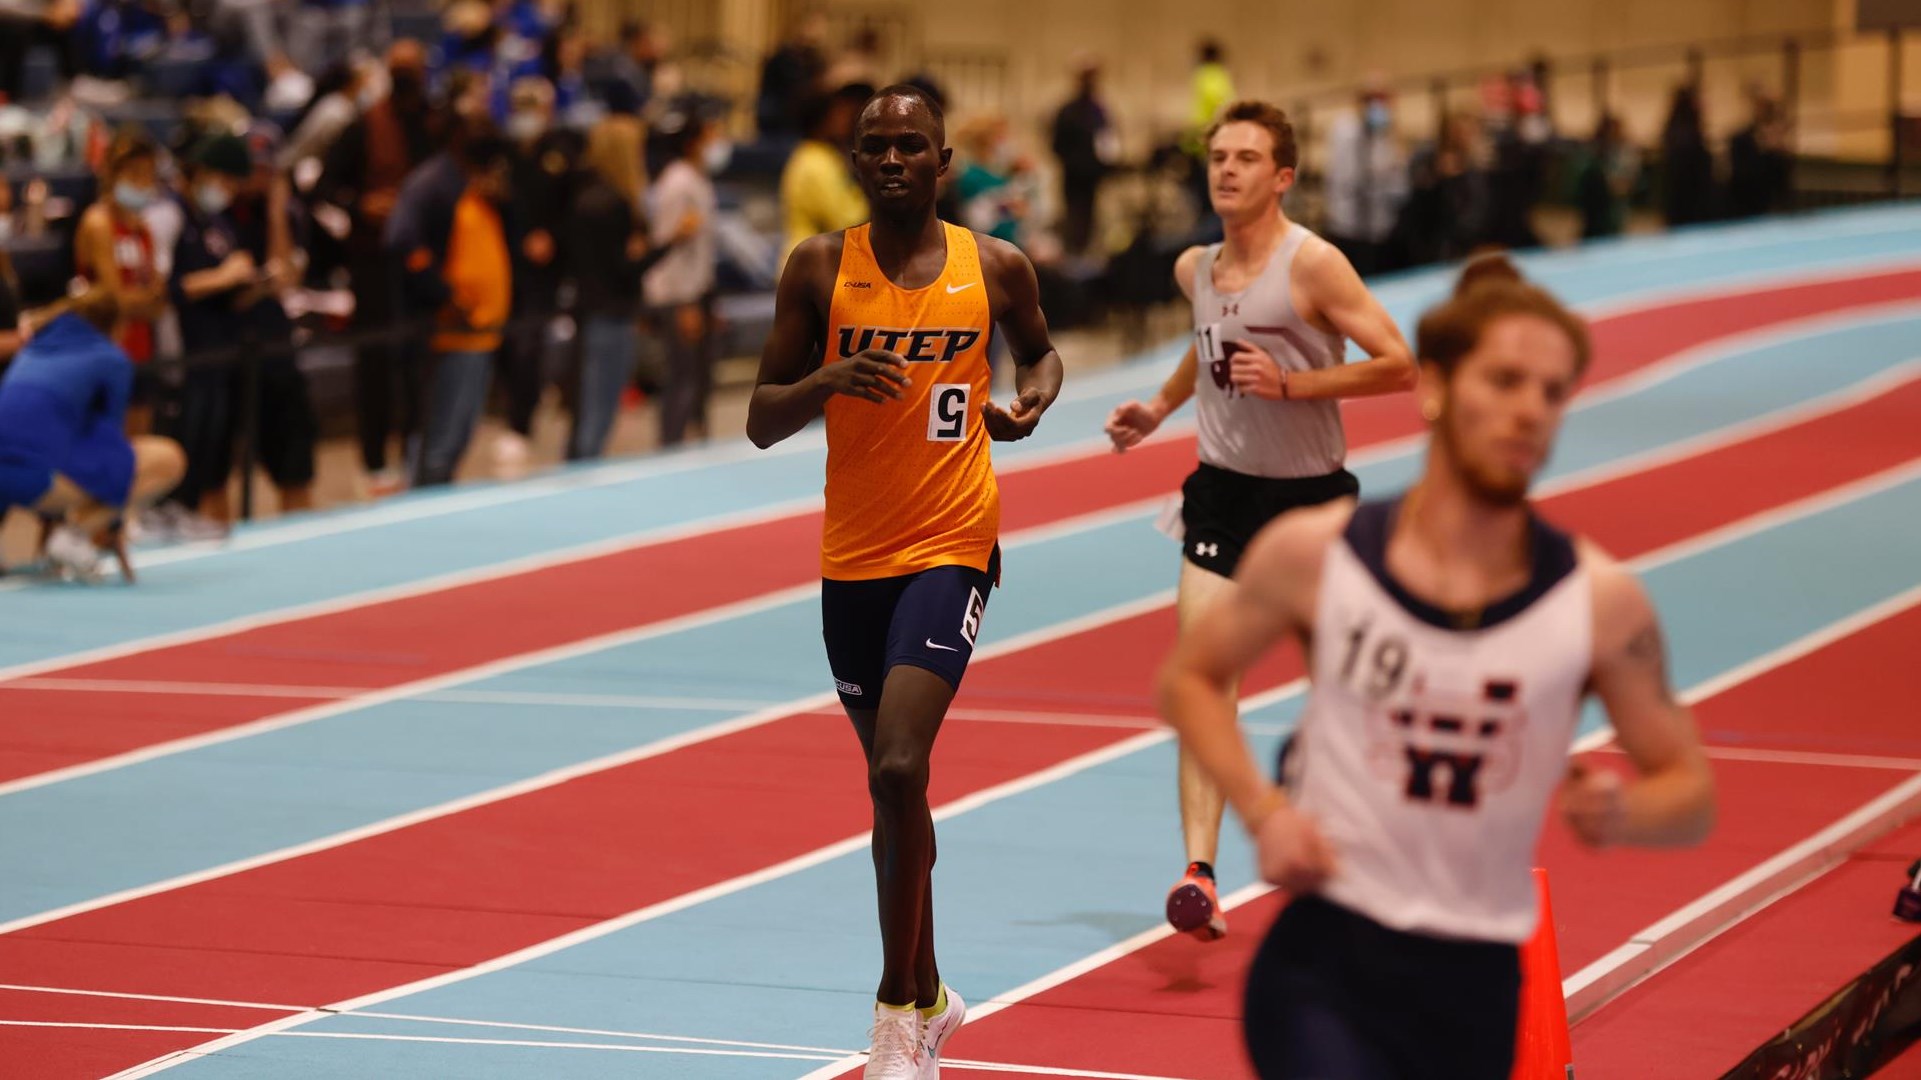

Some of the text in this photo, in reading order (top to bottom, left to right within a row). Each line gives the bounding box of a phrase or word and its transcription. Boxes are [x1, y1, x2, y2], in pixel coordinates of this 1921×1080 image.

[838, 327, 981, 362] UTEP
[937, 388, 966, 437] 5
[966, 594, 984, 643] 5
[1340, 621, 1410, 698] 19
